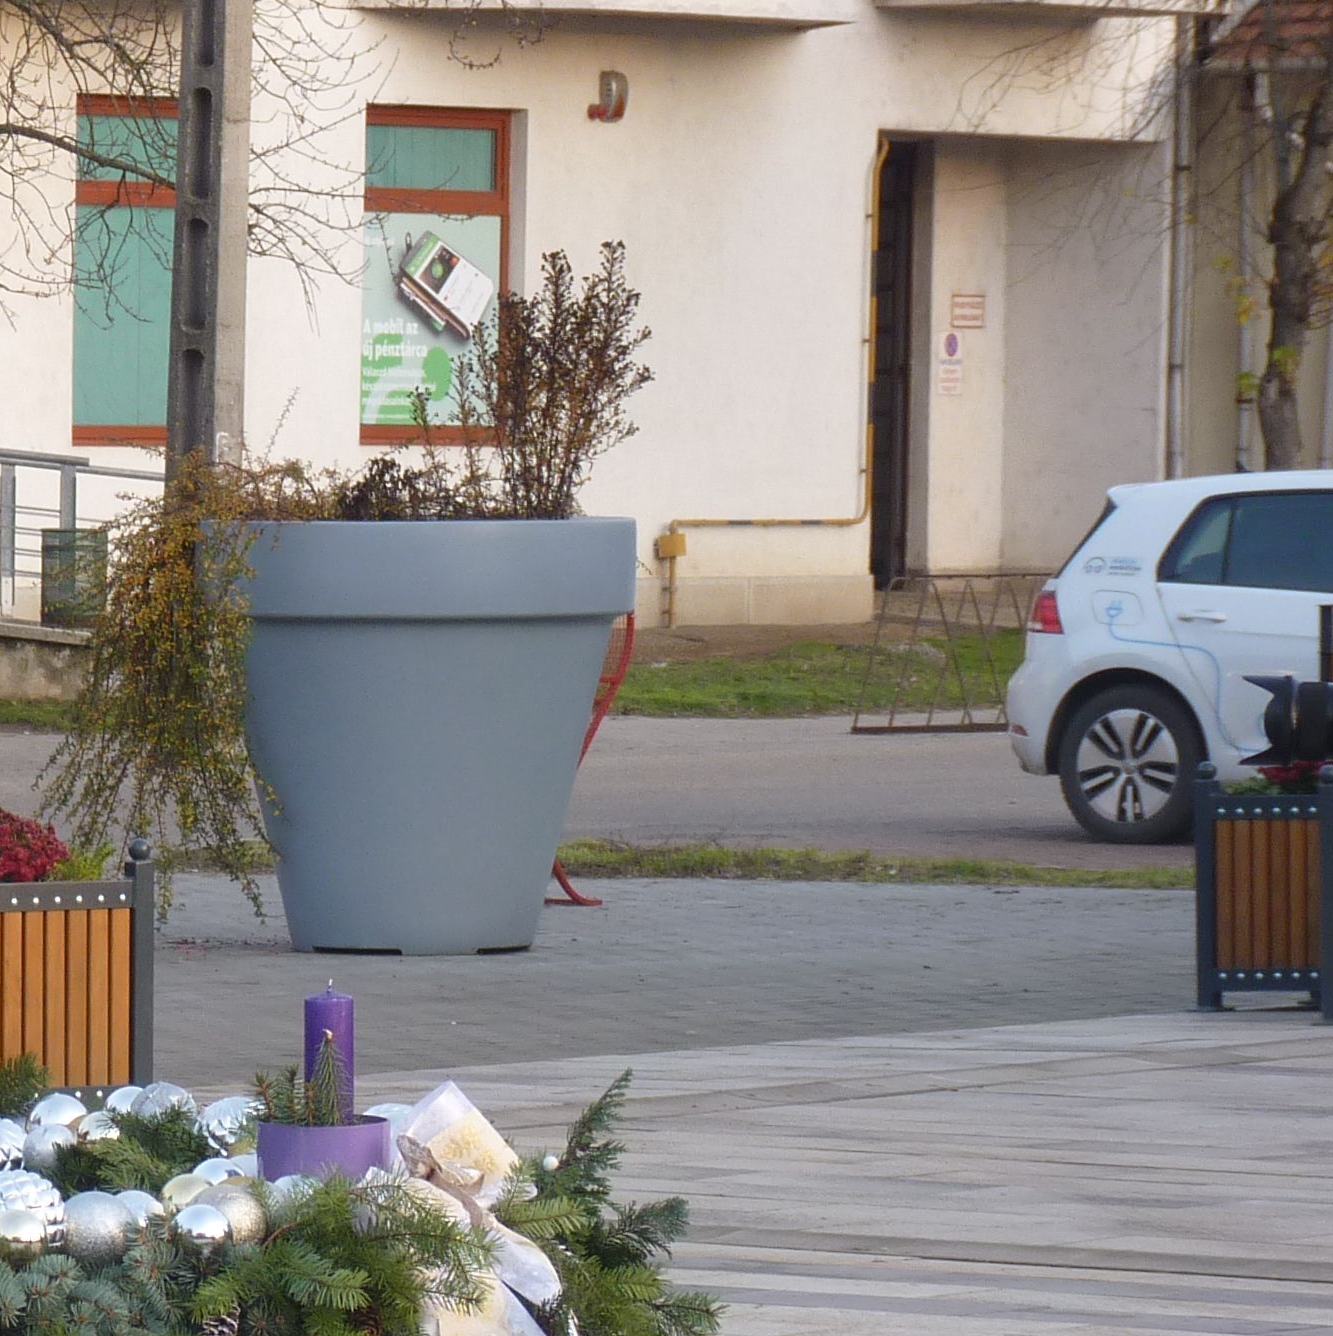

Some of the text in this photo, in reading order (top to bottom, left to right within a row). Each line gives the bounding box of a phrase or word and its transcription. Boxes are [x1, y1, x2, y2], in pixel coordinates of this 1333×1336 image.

[363, 319, 371, 333] A
[406, 323, 418, 335] az
[375, 340, 427, 360] pénztárca
